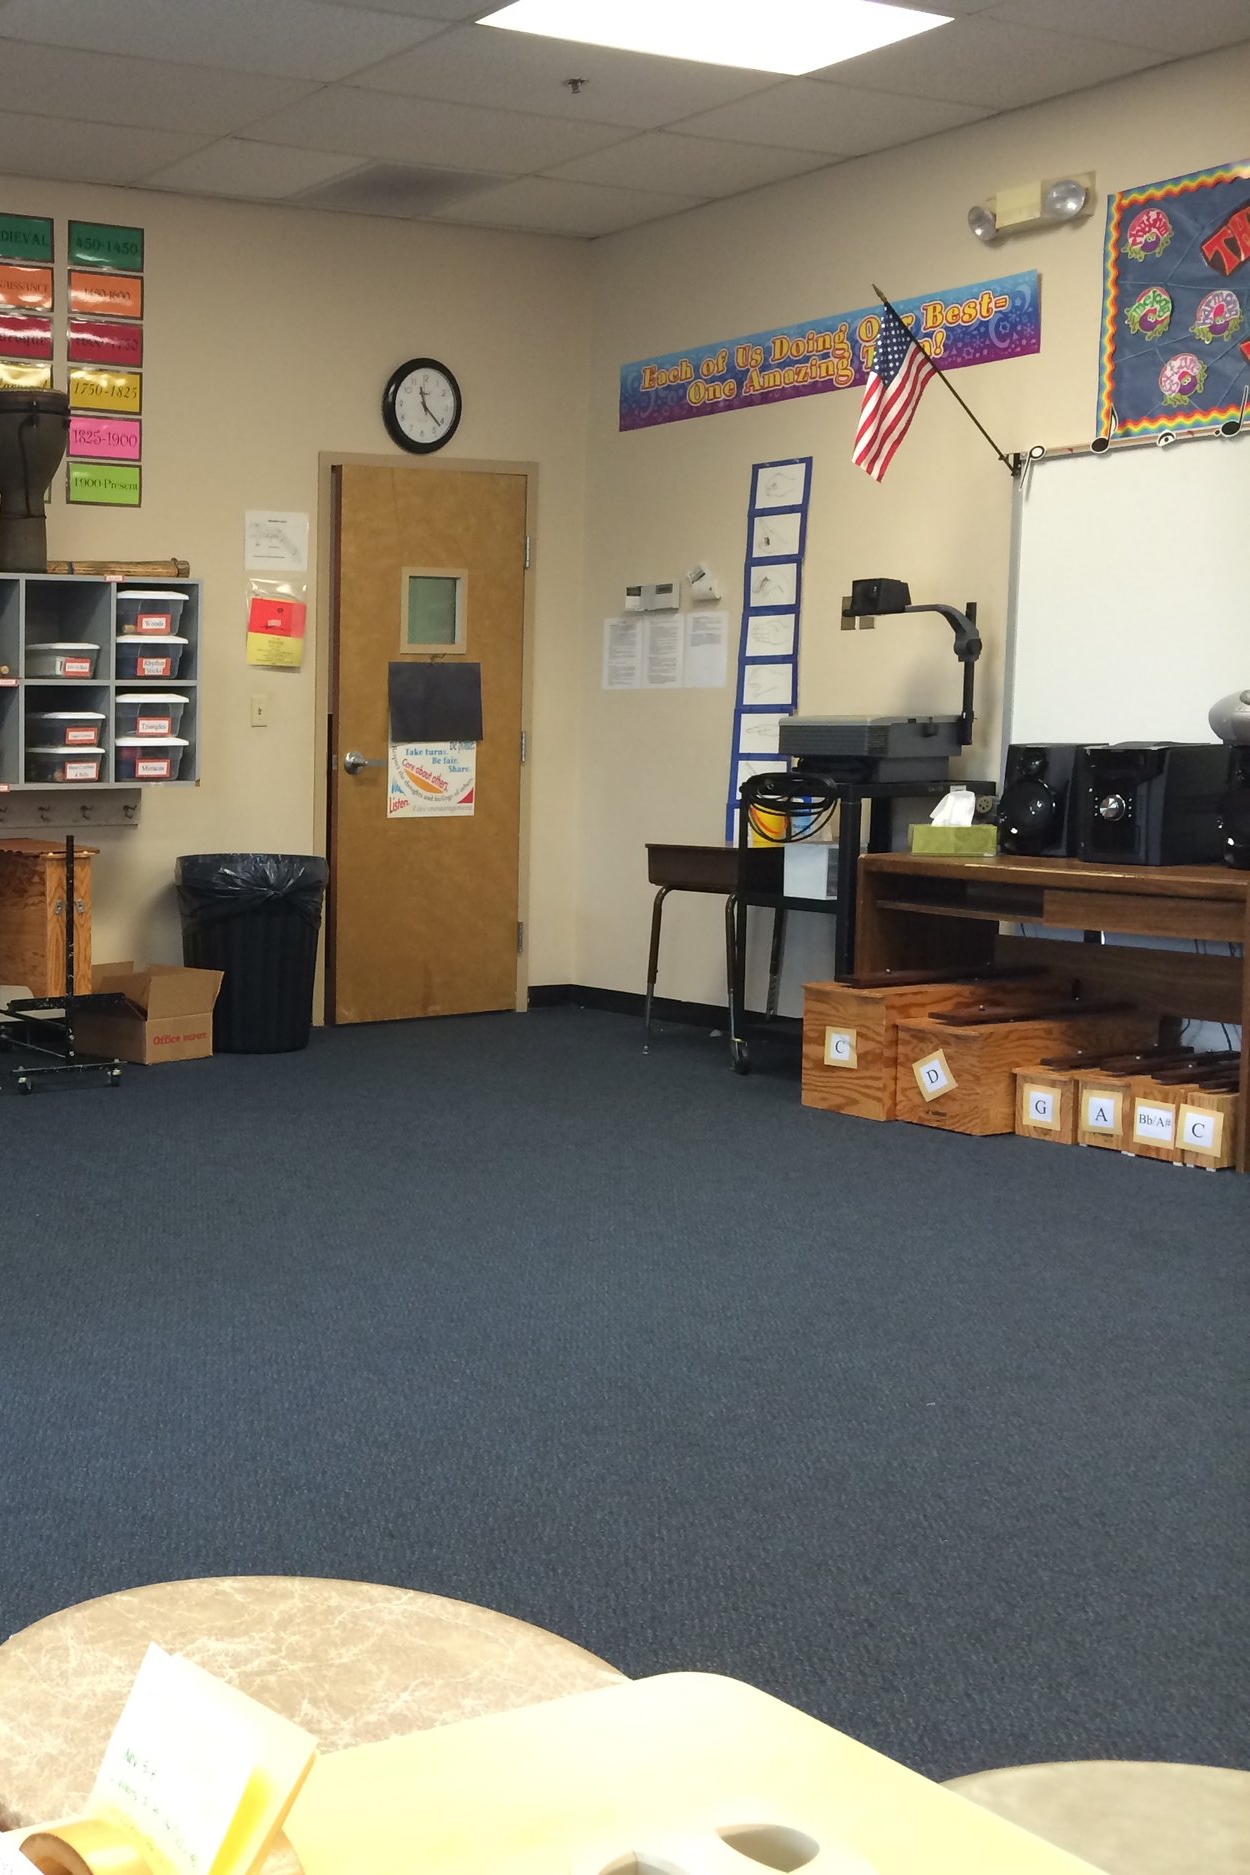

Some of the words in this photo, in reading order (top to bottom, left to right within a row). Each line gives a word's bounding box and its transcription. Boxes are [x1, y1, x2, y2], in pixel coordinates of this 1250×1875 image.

[76, 237, 138, 256] 450-1450
[1132, 289, 1171, 319] melody
[641, 358, 693, 390] Each
[700, 347, 728, 378] of
[735, 344, 764, 369] Us
[770, 322, 850, 359] Doing
[857, 313, 915, 343] Or
[74, 381, 138, 399] 1750-1825
[688, 379, 737, 406] One
[743, 358, 854, 388] Amazing
[72, 429, 138, 448] 1825-1900
[415, 766, 432, 780] about
[153, 1033, 181, 1045] Office
[835, 1040, 845, 1054] C
[926, 1069, 939, 1084] D
[1035, 1099, 1047, 1115] G
[1095, 1107, 1108, 1122] A
[1138, 1113, 1171, 1128] Bb/A#
[1191, 1122, 1205, 1138] C
